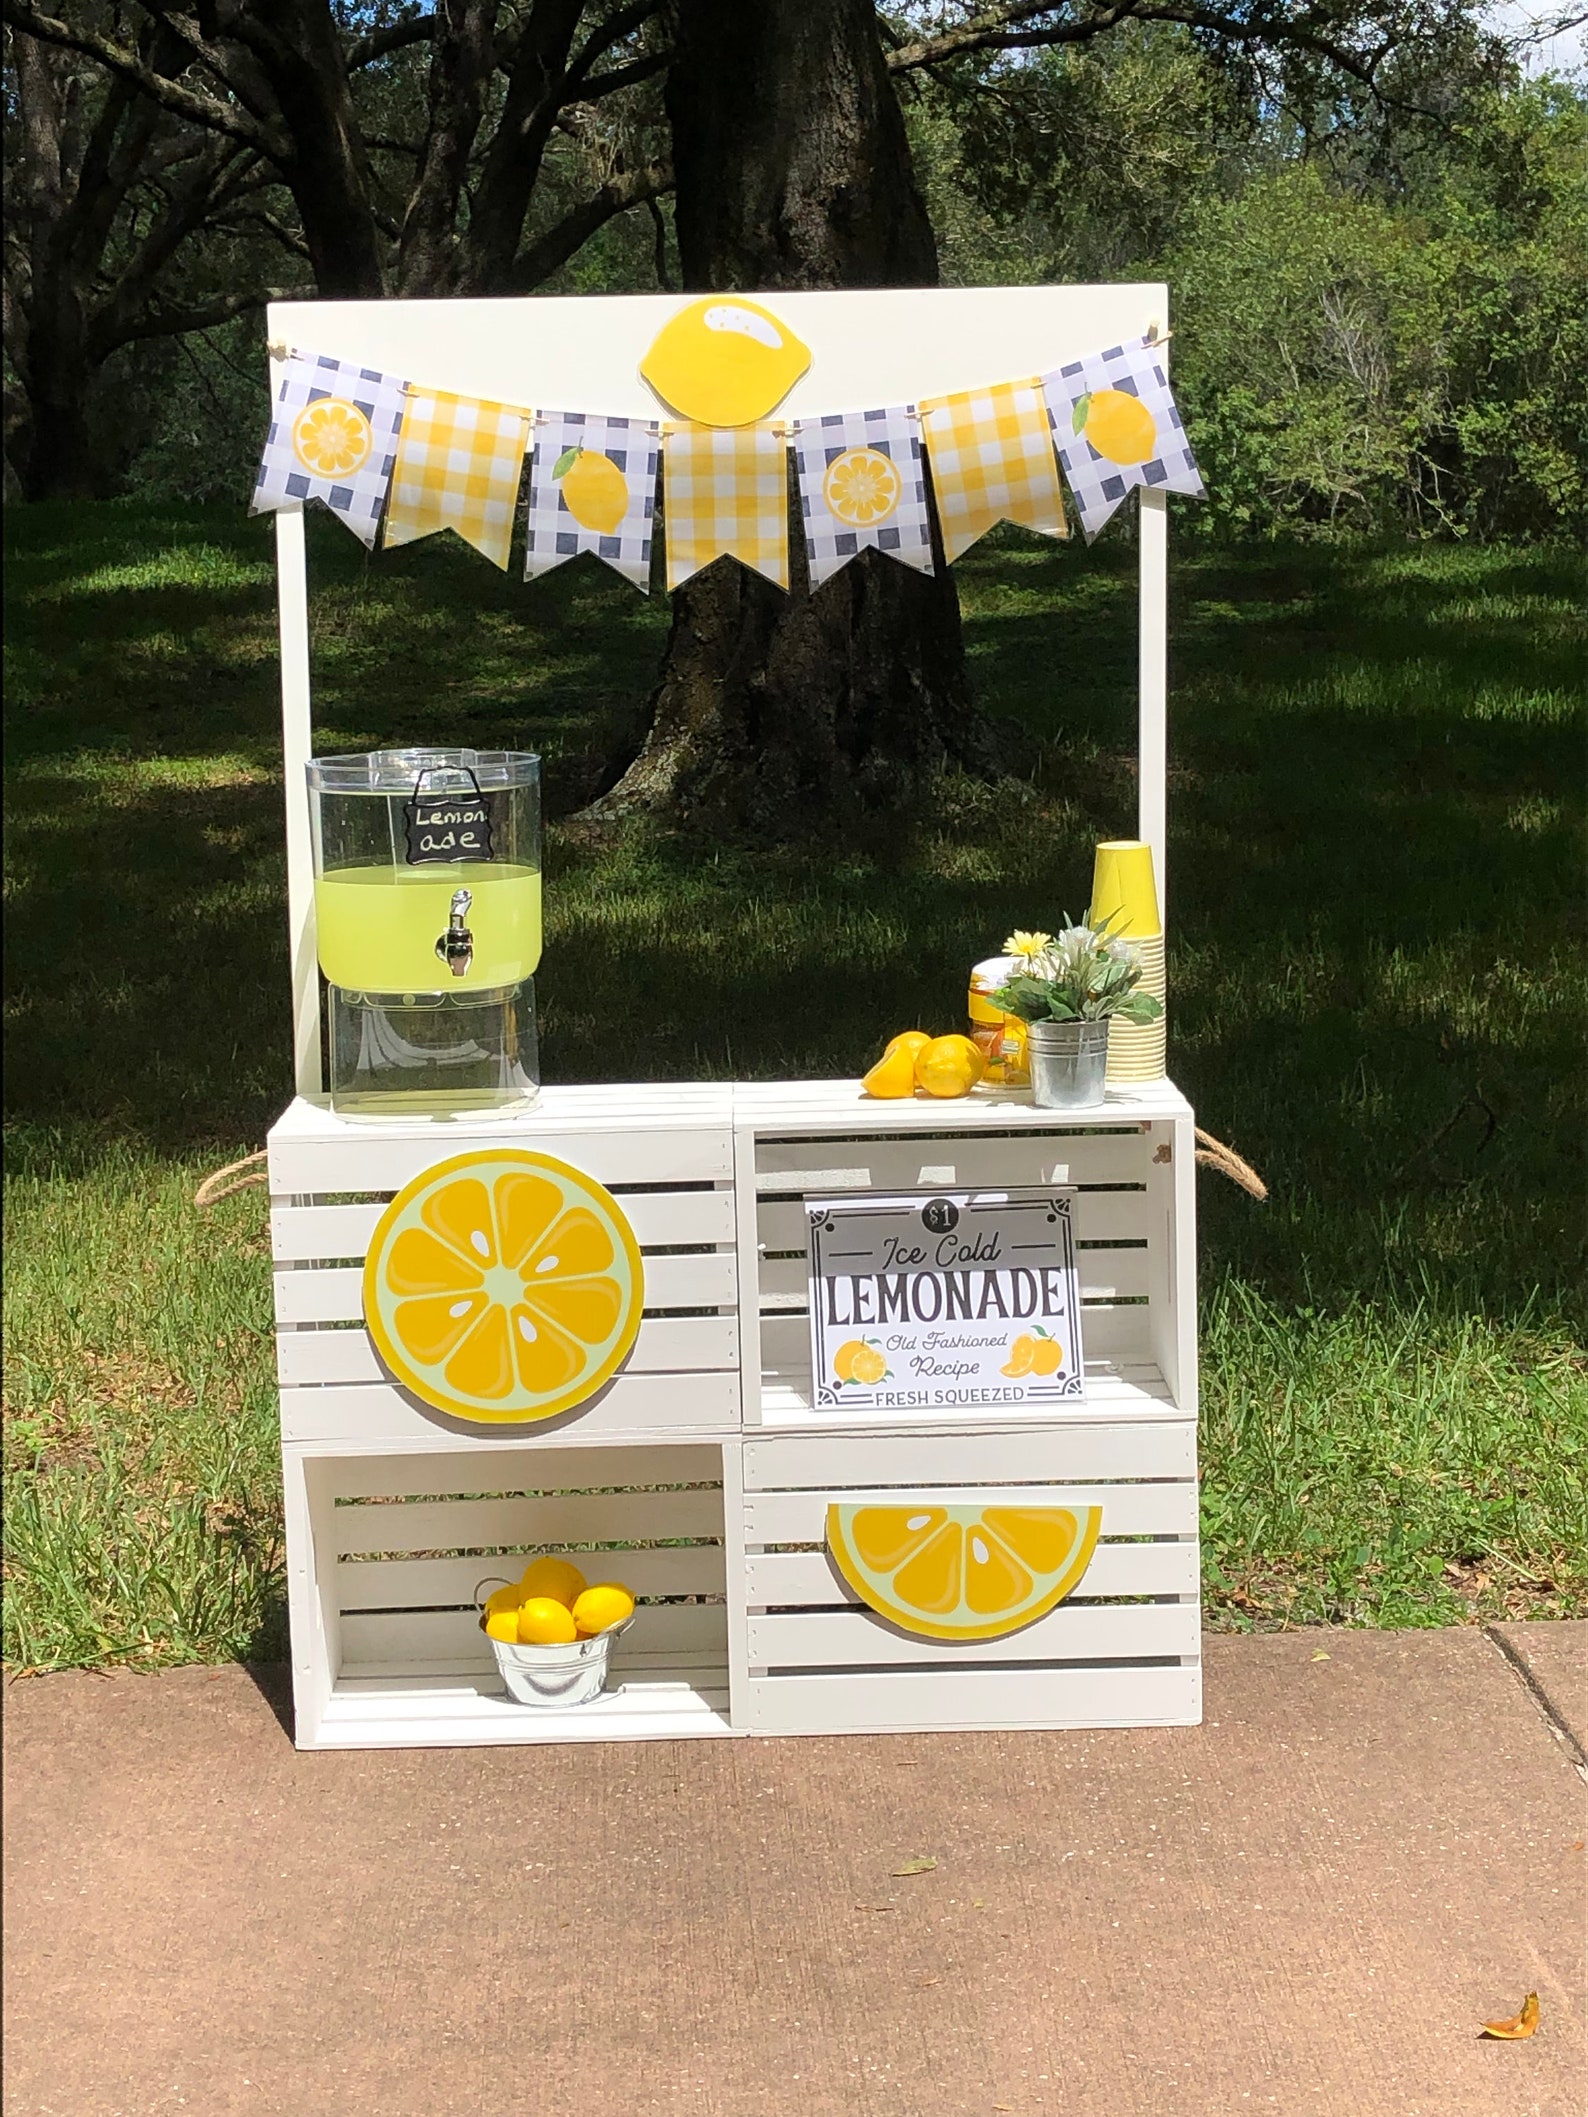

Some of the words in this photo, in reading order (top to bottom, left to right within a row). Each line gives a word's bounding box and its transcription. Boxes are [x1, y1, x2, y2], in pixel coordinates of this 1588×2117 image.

[416, 809, 485, 825] Lemon
[420, 831, 481, 851] ade
[930, 1203, 952, 1227] $1
[882, 1236, 927, 1270] Ice
[935, 1231, 1001, 1267] Cold
[825, 1266, 1065, 1326] LEMONADE
[886, 1334, 917, 1351] Old
[922, 1331, 1008, 1351] Fashioned
[909, 1355, 980, 1381] Recipe
[876, 1389, 929, 1406] FRESH
[934, 1387, 1024, 1405] SQUEEZED
